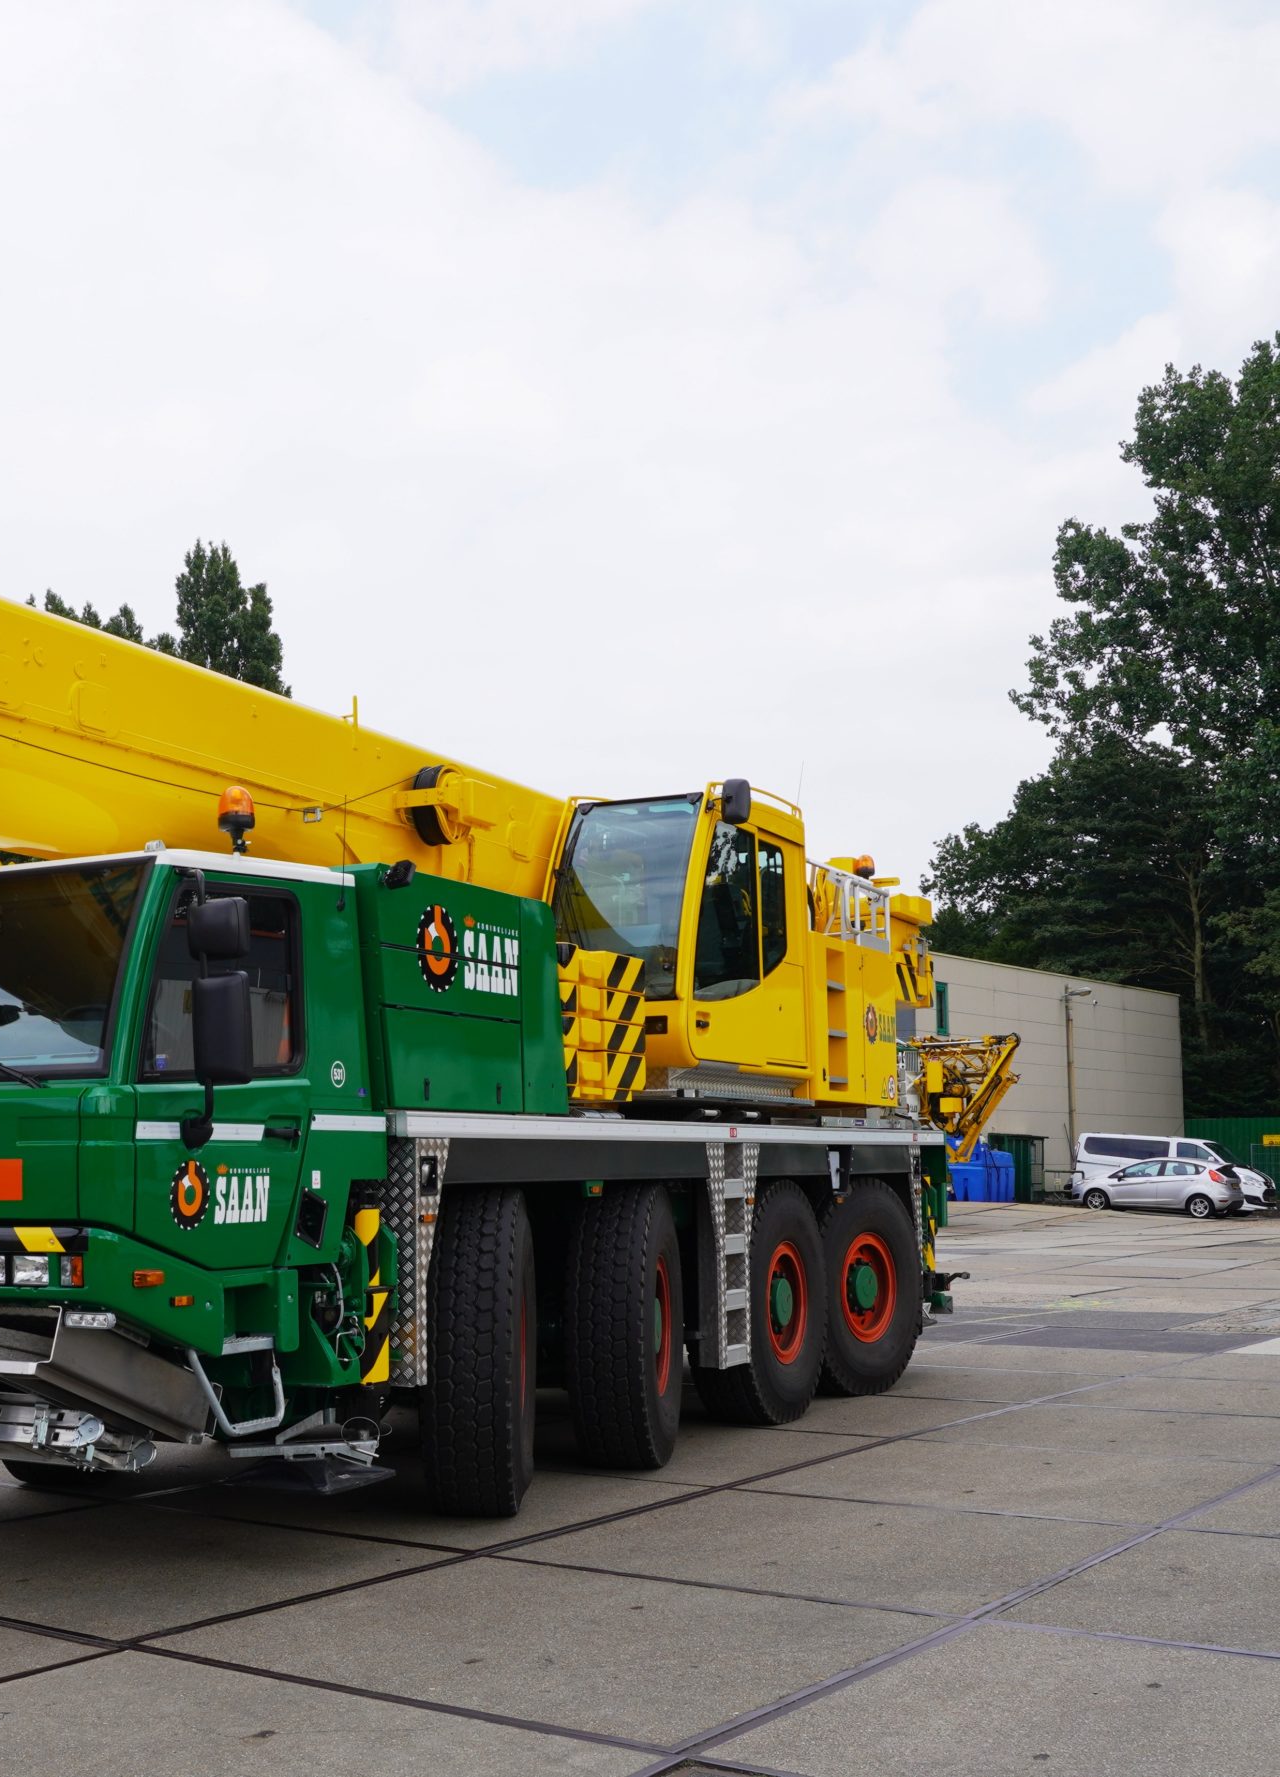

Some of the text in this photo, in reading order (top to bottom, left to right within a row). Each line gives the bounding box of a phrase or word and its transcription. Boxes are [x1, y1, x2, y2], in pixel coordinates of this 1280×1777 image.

[463, 929, 519, 996] SAAN
[333, 1068, 344, 1080] 531
[214, 1176, 270, 1224] SAAN
